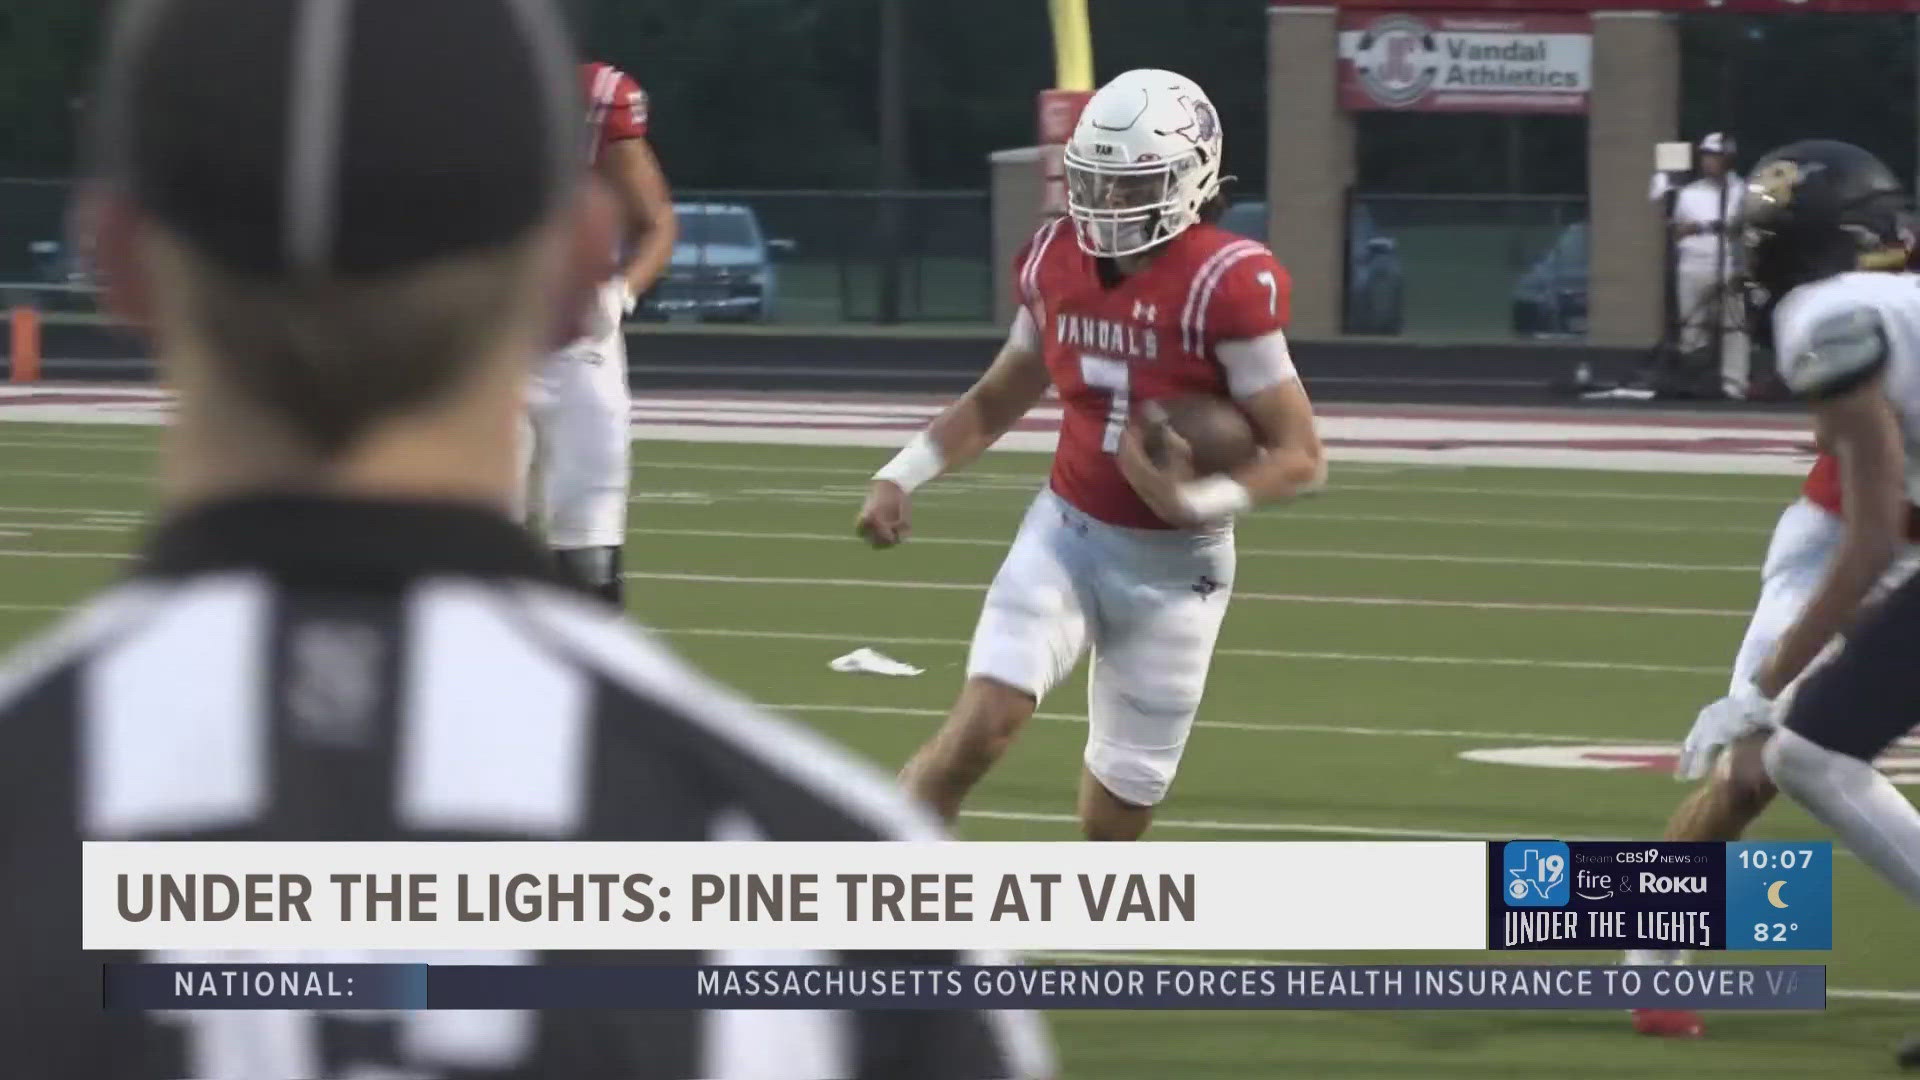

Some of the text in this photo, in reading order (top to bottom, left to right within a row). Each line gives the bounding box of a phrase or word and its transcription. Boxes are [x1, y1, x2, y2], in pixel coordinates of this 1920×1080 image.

[1446, 38, 1546, 62] Vandal
[1445, 64, 1579, 87] Athletics
[1256, 271, 1277, 316] 7
[1057, 312, 1157, 359] VANDALS
[1080, 355, 1129, 454] 7
